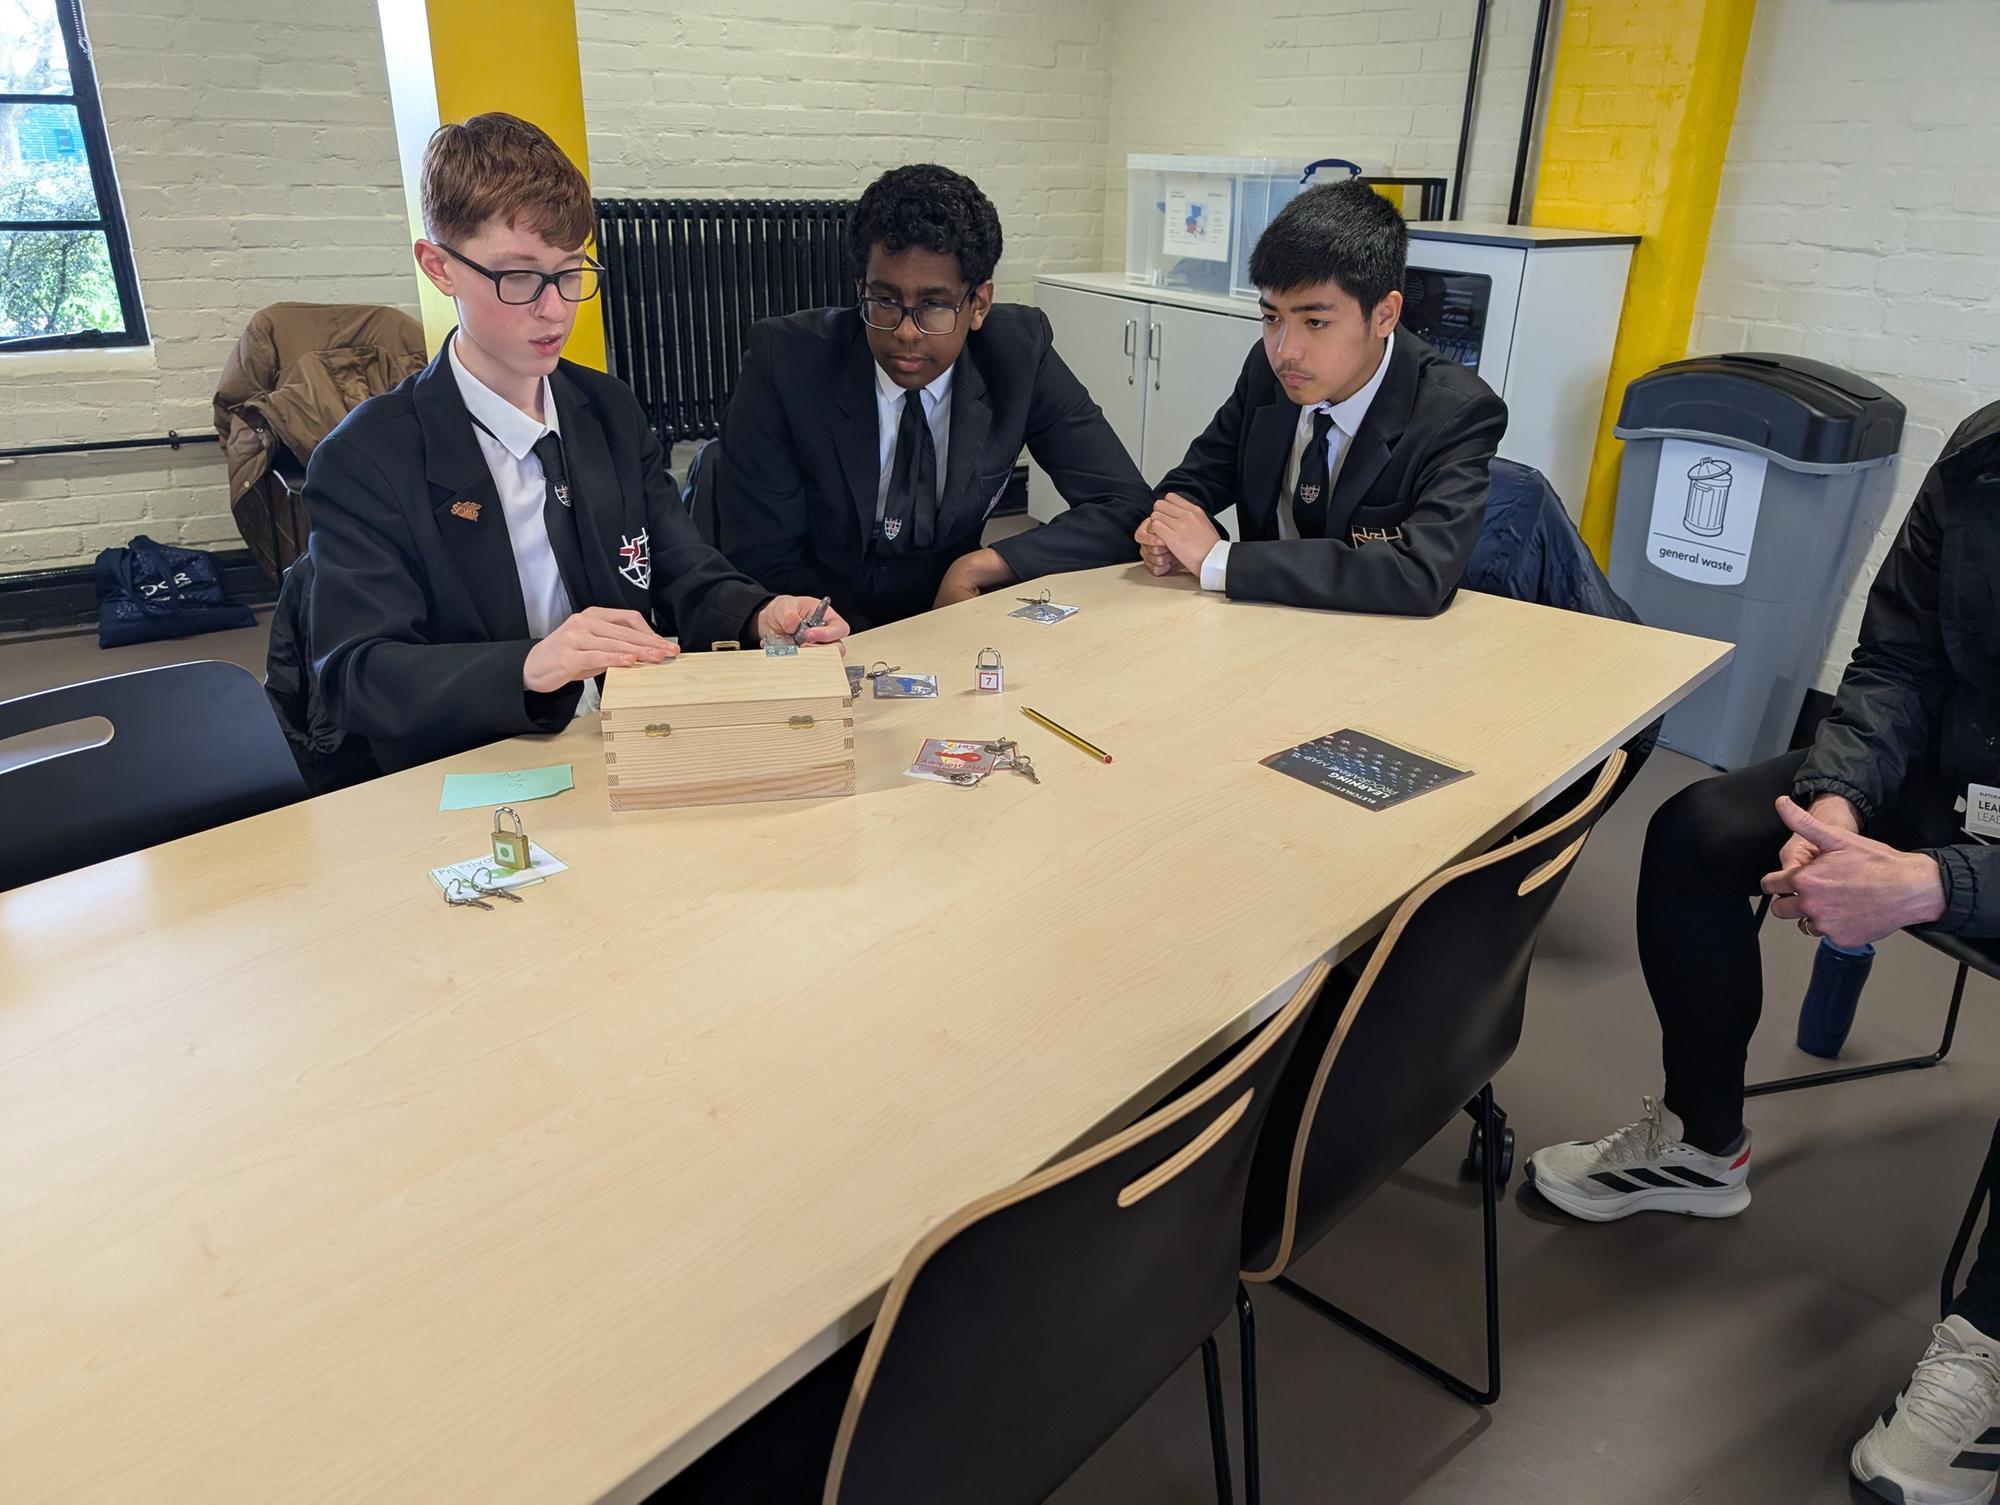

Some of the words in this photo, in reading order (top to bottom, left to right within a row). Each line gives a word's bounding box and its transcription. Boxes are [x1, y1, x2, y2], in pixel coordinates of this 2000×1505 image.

[1659, 547, 1699, 563] general
[1701, 558, 1733, 573] waste
[986, 677, 992, 686] 7
[1327, 772, 1391, 799] LEARNING
[1978, 800, 2000, 813] LEA
